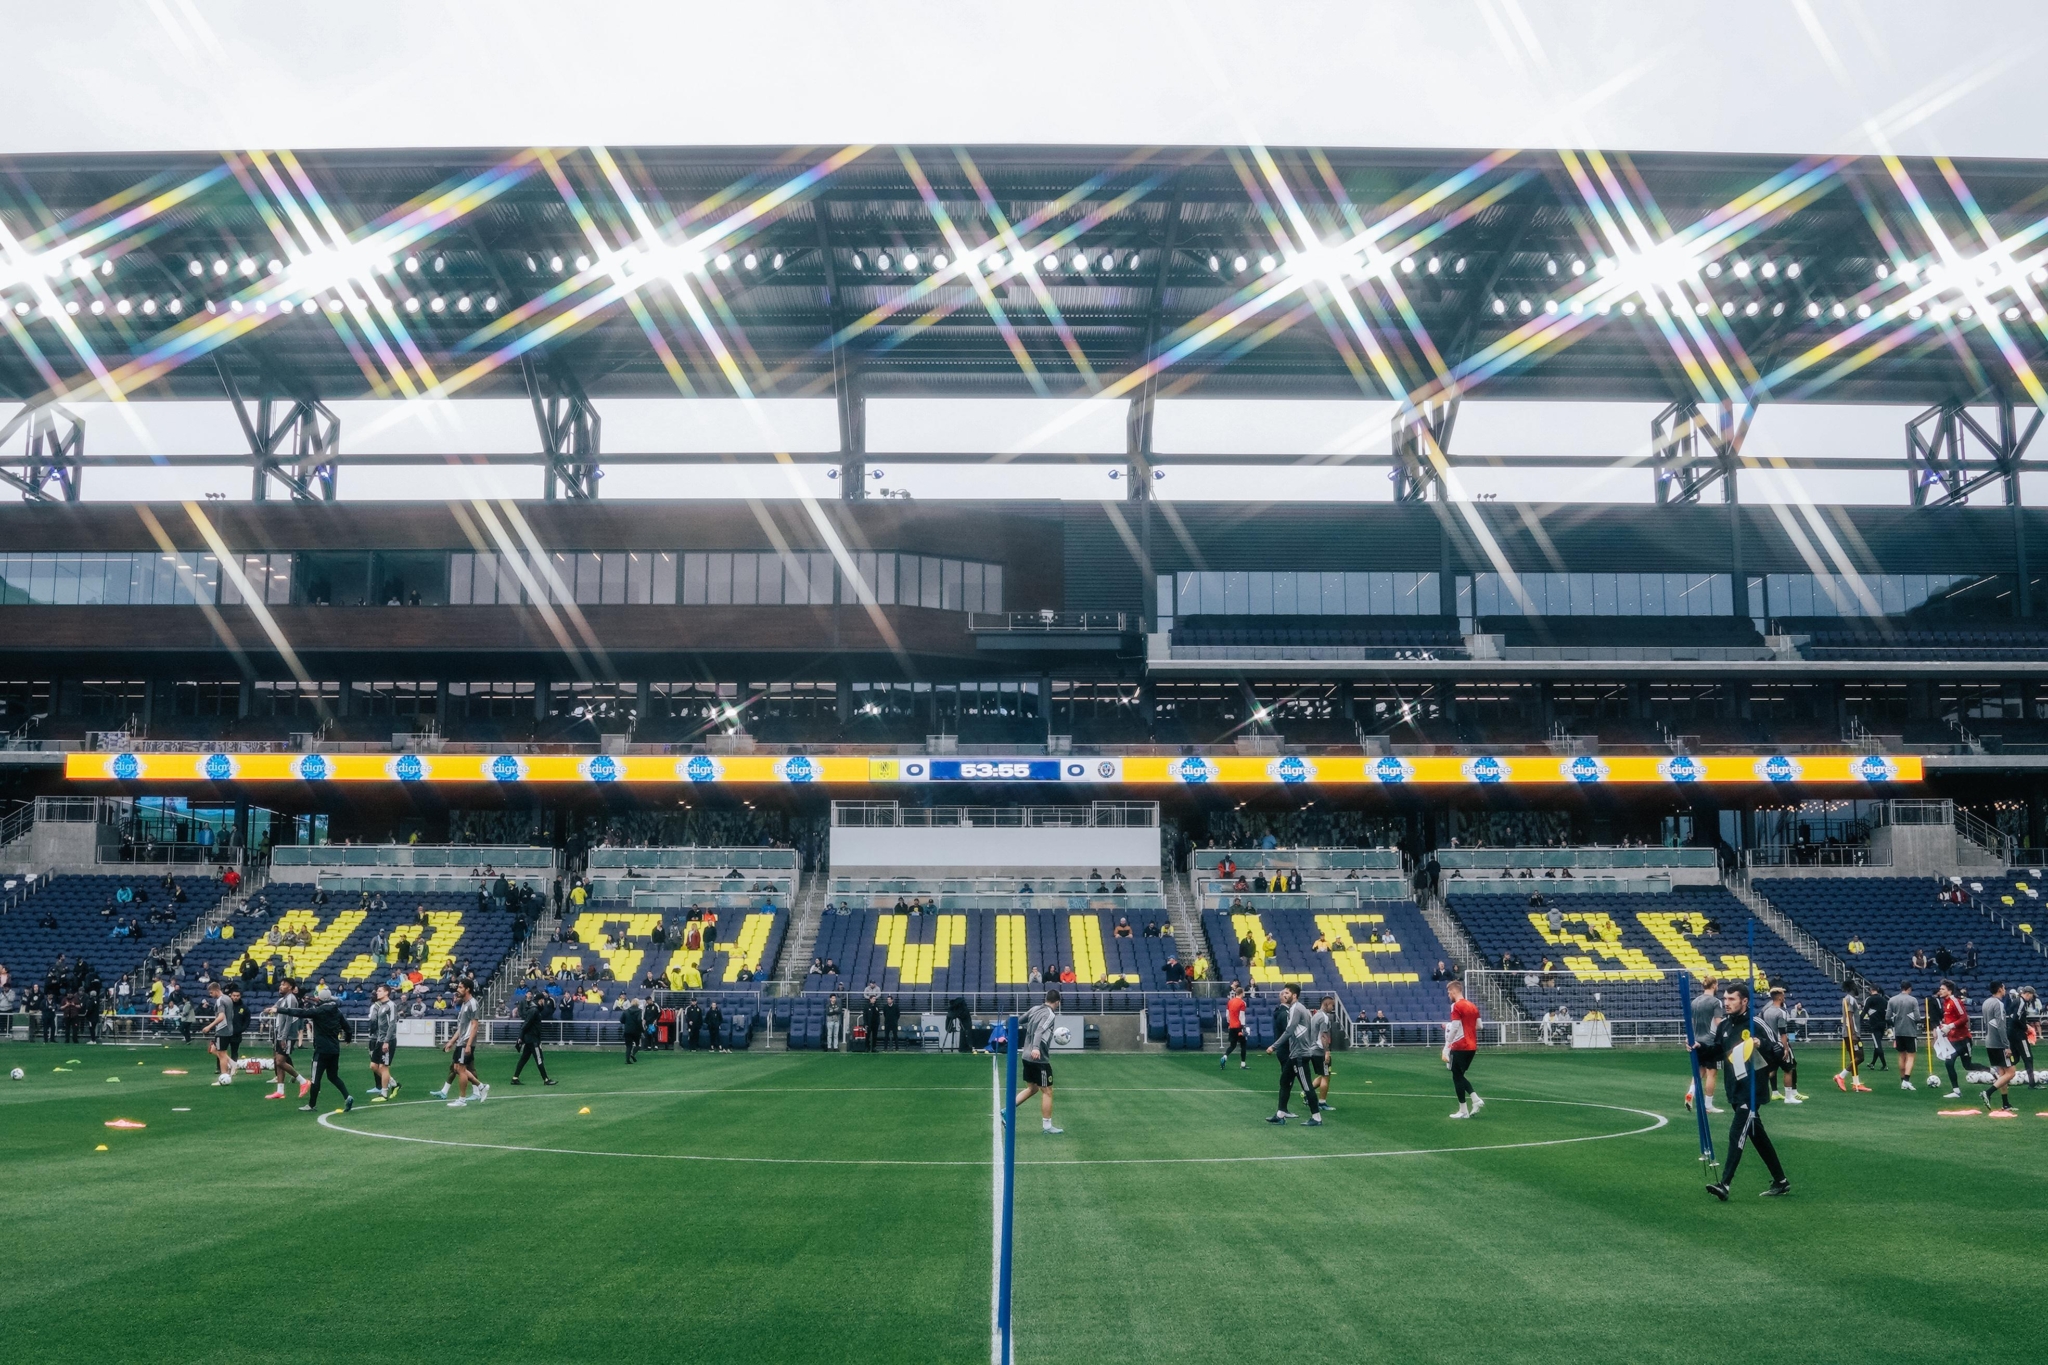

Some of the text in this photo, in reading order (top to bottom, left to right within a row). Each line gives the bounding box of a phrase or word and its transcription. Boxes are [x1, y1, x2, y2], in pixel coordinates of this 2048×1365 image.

[289, 763, 336, 774] Pedigree
[384, 763, 432, 774] Pedigree
[481, 763, 529, 775] Pedigree
[577, 763, 627, 775] Pedigree
[675, 763, 725, 775] Pedigree
[773, 764, 824, 776] Pedigree
[906, 763, 924, 777] 0
[960, 763, 1030, 778] 53:55
[1067, 763, 1085, 777] 0
[1168, 764, 1219, 776] Pedigree
[1266, 764, 1317, 776] Pedigree
[1364, 764, 1415, 776] Pedigree
[1461, 764, 1512, 776] Pedigree
[1559, 764, 1610, 776] Pedigree
[1657, 764, 1707, 776] Pedigree
[1754, 764, 1803, 775] Pedigree
[1849, 764, 1899, 775] Pedigree
